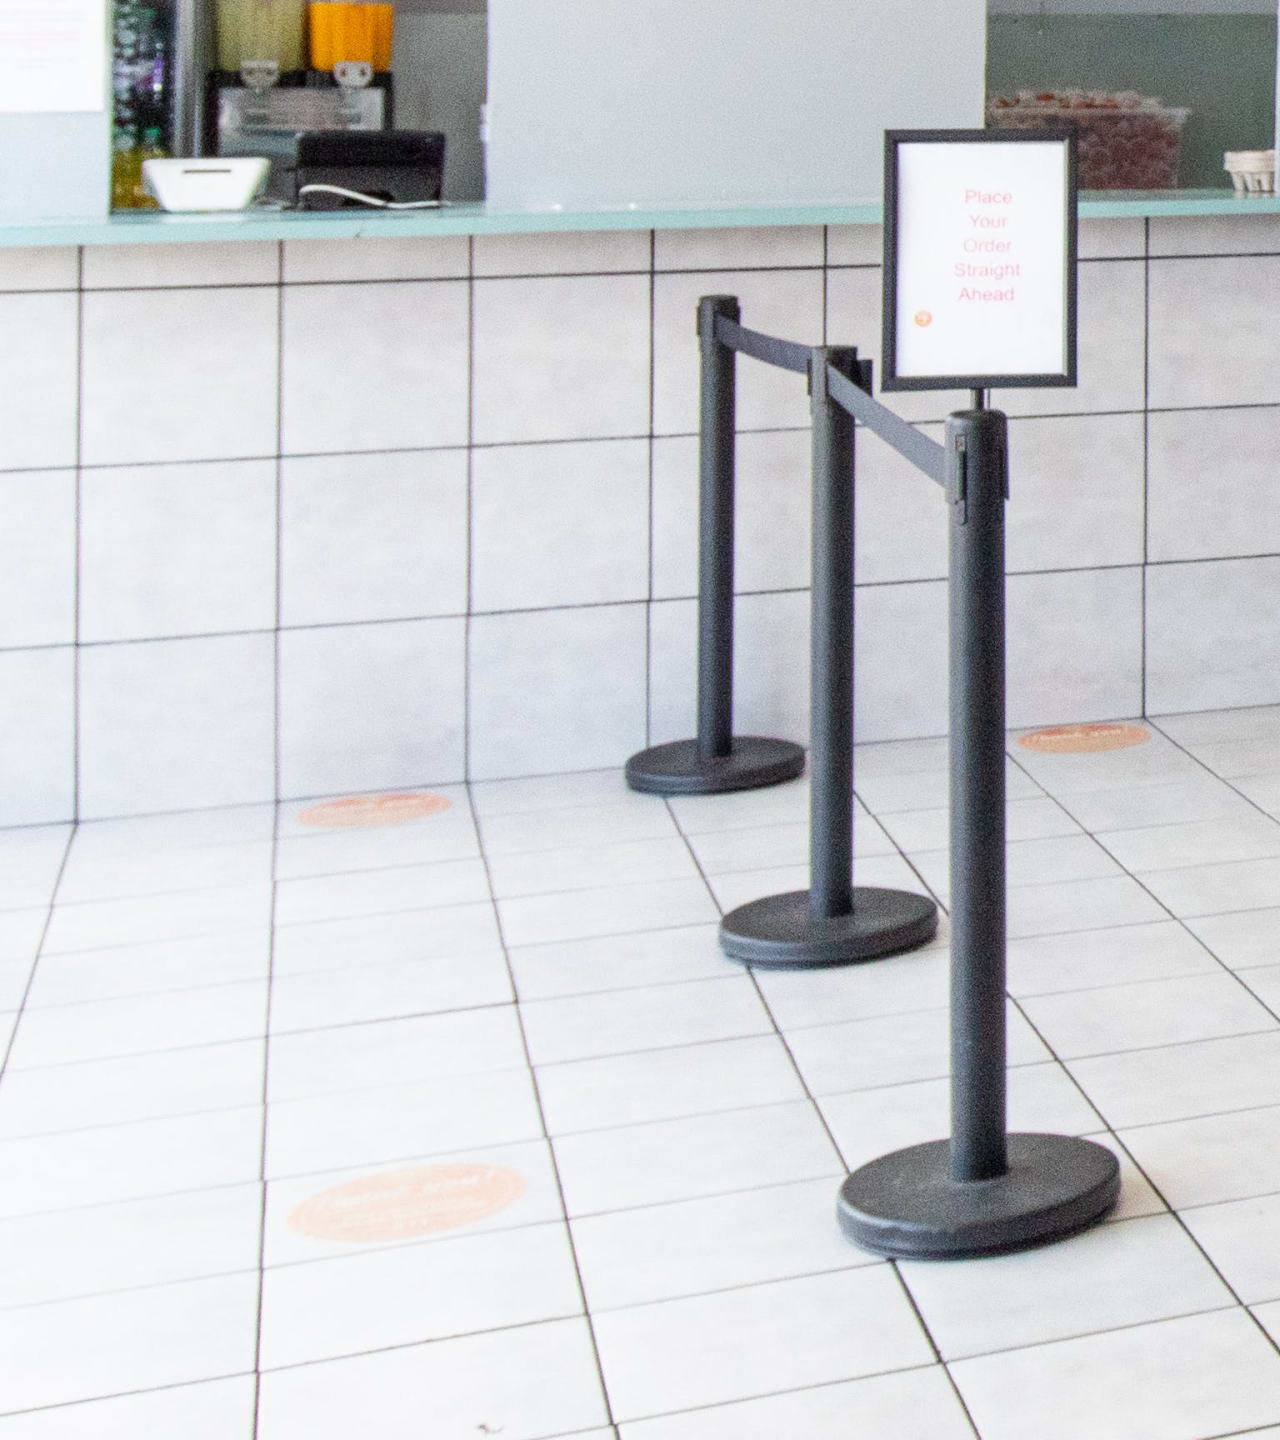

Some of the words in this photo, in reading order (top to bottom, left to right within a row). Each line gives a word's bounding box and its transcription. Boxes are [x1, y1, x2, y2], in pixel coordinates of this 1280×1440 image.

[965, 189, 1013, 205] Place
[969, 214, 1007, 229] Your
[963, 238, 1012, 253] Order
[953, 262, 1020, 280] Straight
[958, 286, 1016, 302] Ahead
